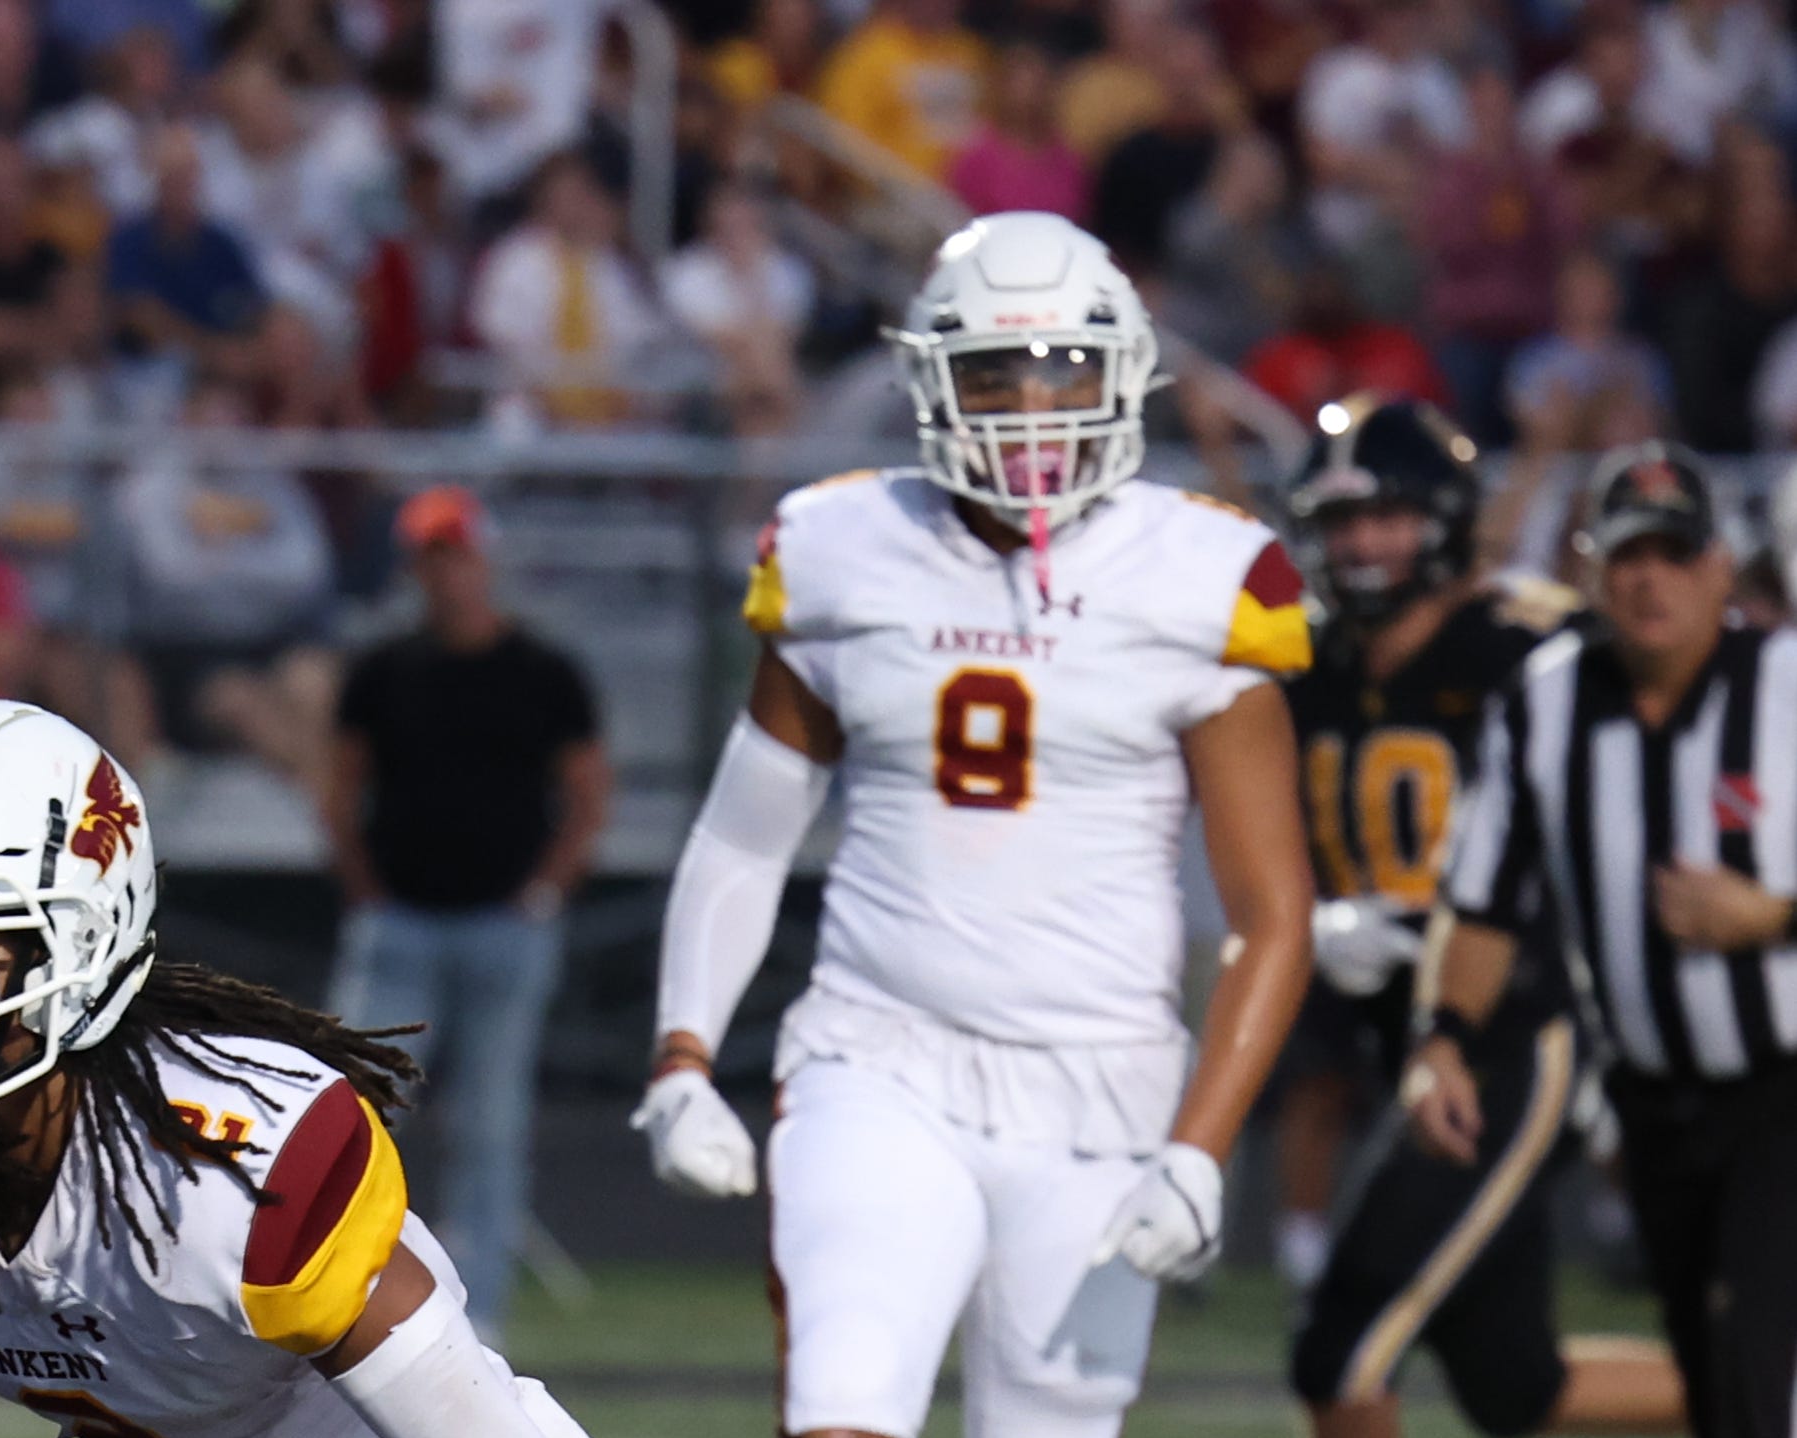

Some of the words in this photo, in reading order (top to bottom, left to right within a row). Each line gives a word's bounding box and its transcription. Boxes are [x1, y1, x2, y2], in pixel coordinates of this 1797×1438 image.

[930, 626, 1060, 663] ANKENY
[934, 663, 1038, 813] 8
[1307, 726, 1458, 908] 10
